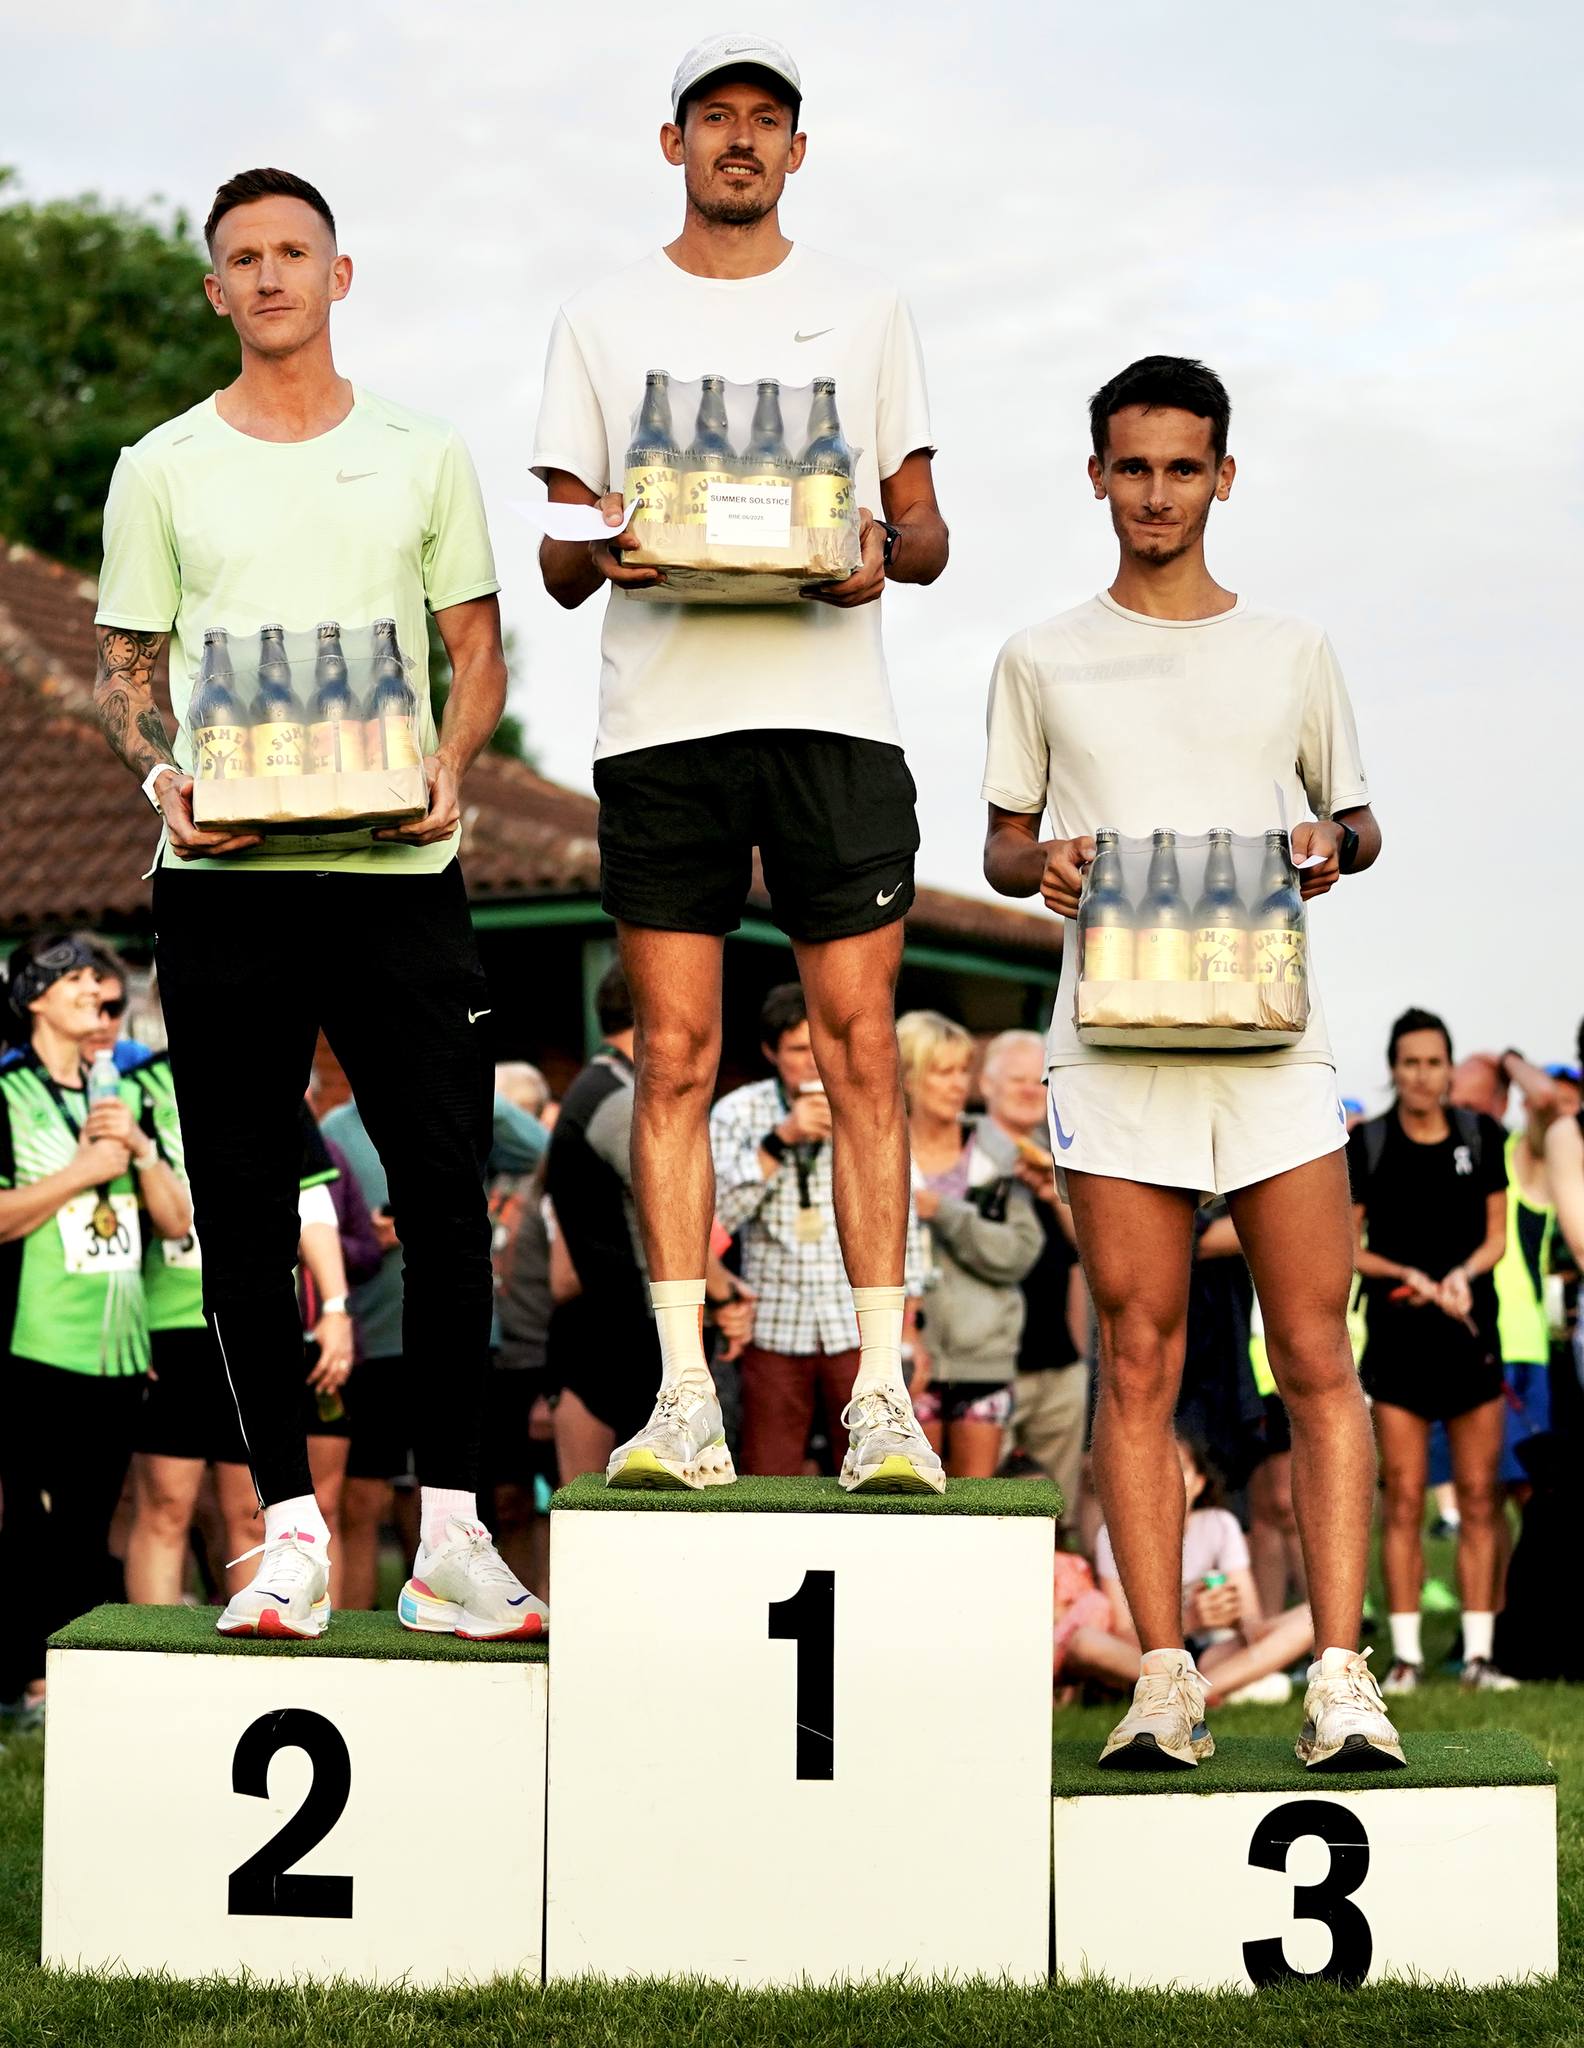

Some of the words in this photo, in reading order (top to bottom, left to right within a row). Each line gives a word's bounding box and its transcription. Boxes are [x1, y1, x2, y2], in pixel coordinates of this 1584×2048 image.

[710, 494, 747, 504] SUMMER
[749, 496, 790, 506] SOLSTICE
[769, 1571, 834, 1780] 1
[228, 1709, 354, 1918] 2
[1243, 1800, 1373, 1992] 3
